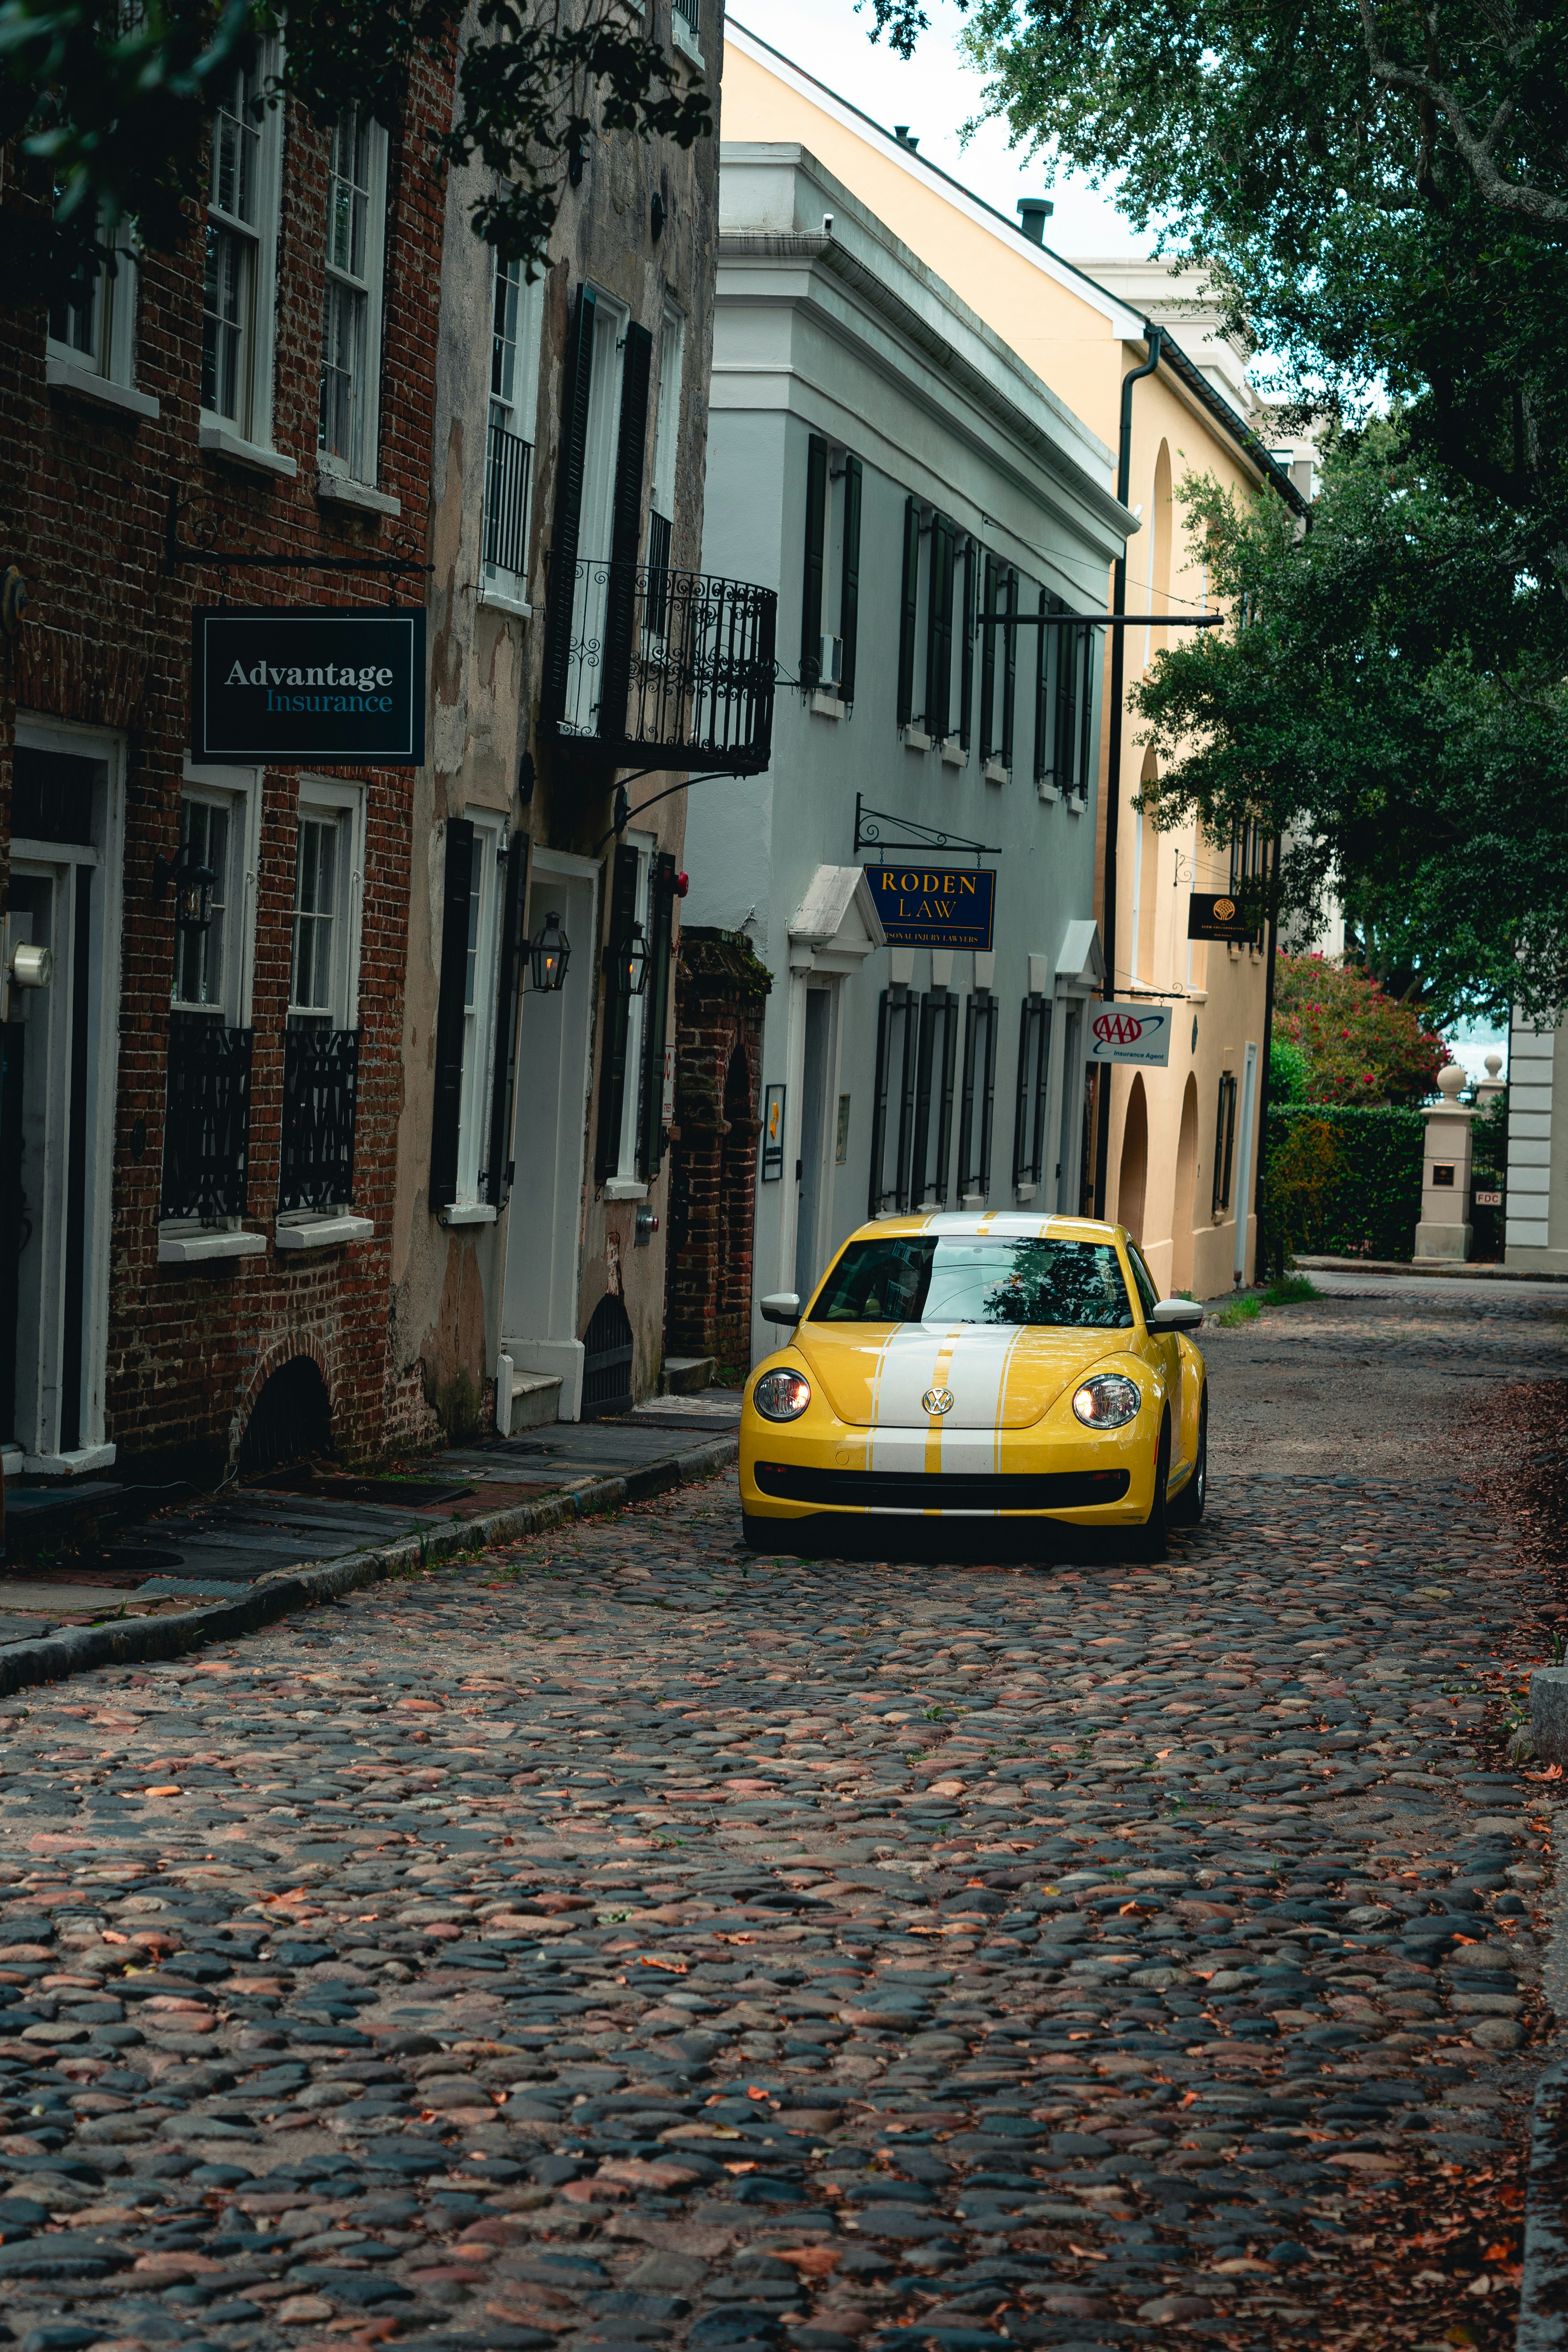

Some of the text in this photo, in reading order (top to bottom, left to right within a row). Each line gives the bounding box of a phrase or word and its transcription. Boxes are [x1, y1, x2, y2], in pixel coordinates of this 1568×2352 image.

[224, 660, 393, 691] Advantage
[266, 690, 393, 712] Insurance
[882, 873, 977, 894] RODEN
[899, 899, 957, 918] LAW
[1096, 1014, 1138, 1044] AAA
[1478, 1194, 1499, 1203] FDC
